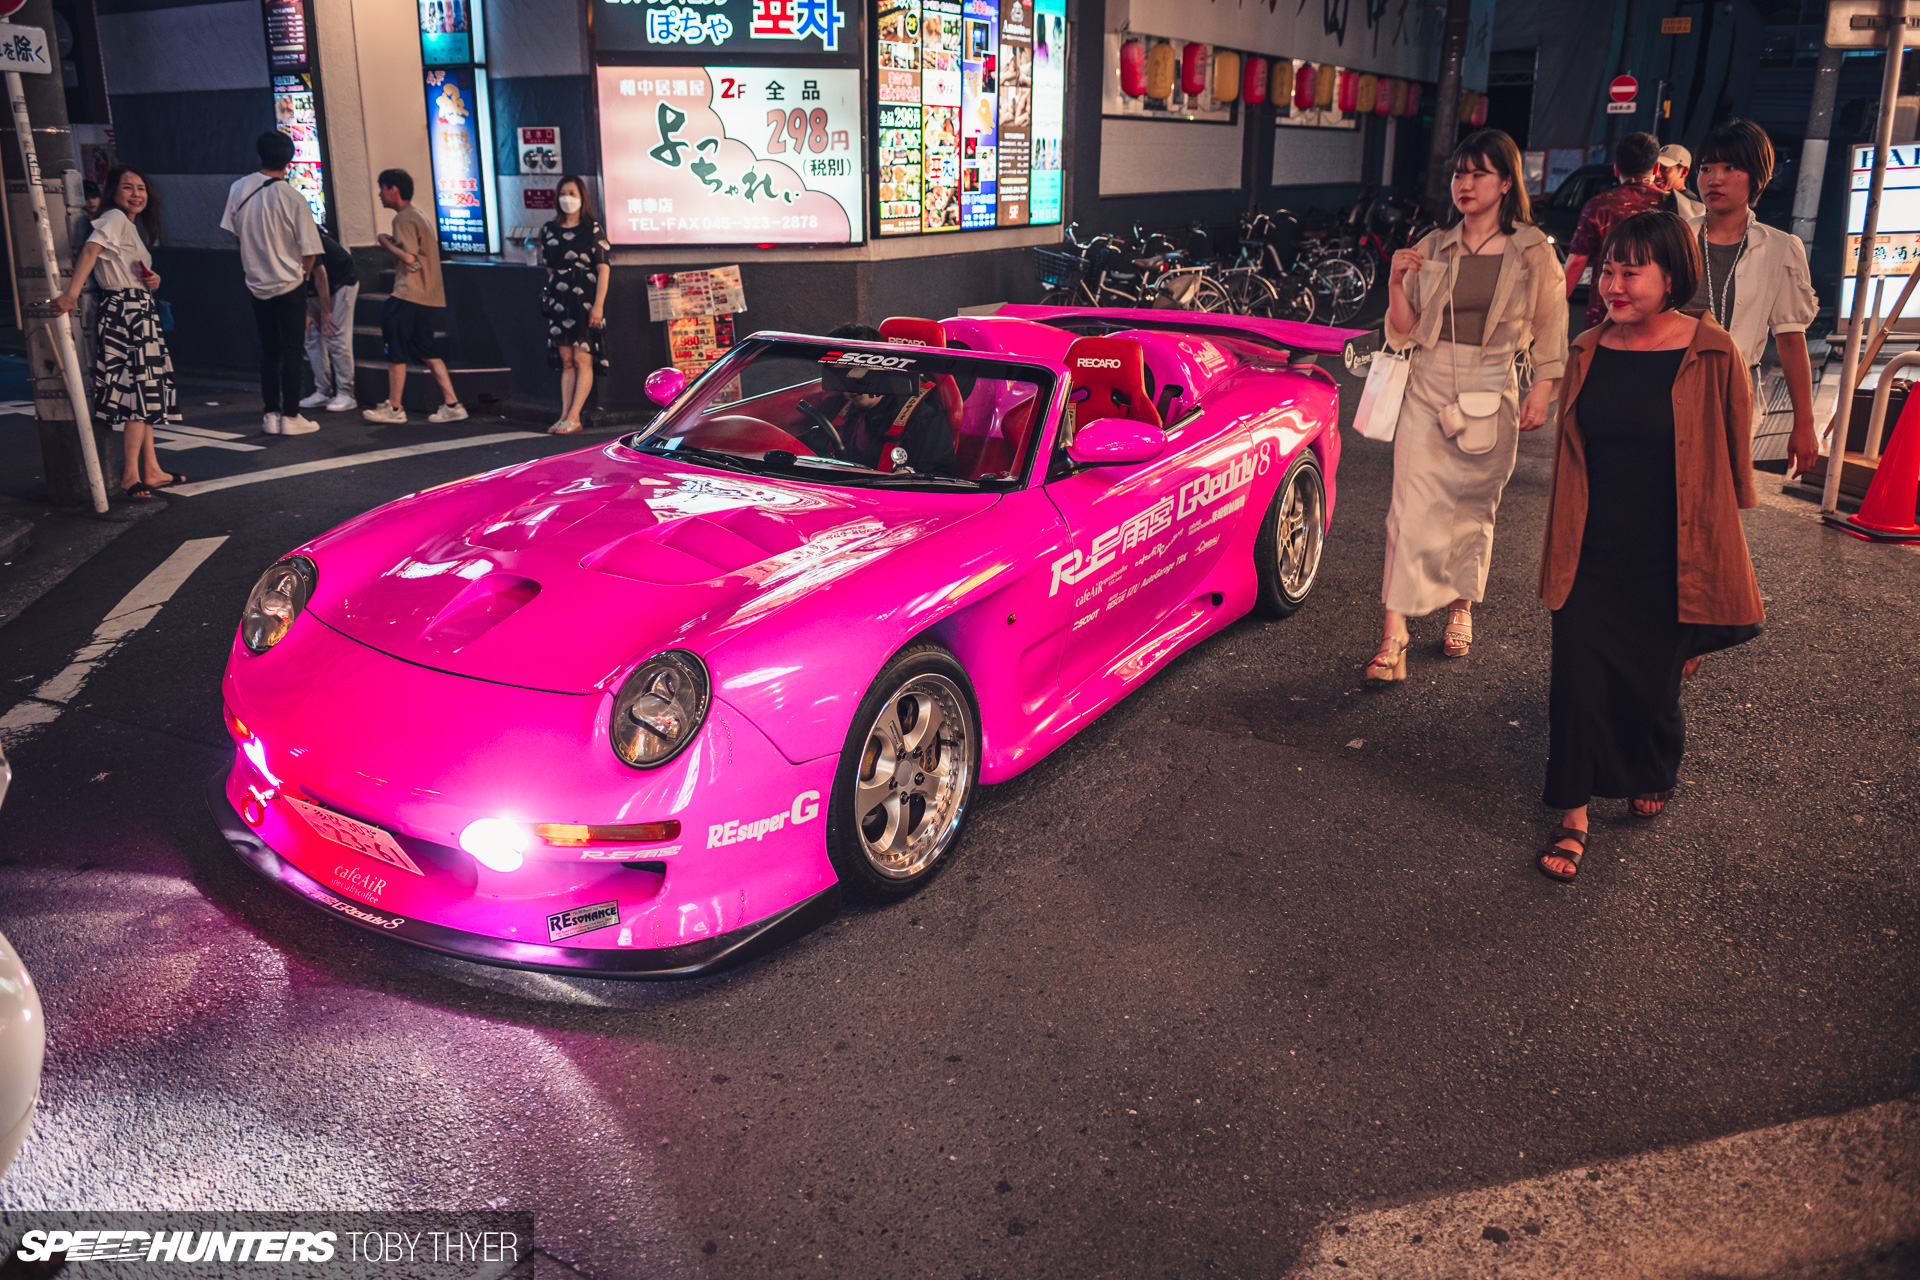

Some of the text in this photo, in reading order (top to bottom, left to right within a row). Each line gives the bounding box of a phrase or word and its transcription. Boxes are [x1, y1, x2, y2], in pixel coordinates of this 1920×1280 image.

[648, 8, 731, 43] ぽちゃ
[752, 0, 842, 48] 포차
[427, 71, 445, 86] 4F
[720, 78, 821, 101] 2F 全品
[766, 107, 850, 154] 298円
[888, 336, 926, 347] RECARO
[838, 352, 917, 369] SCOOT
[1077, 358, 1121, 369] RECARO
[1075, 580, 1103, 607] cafeAiR
[334, 865, 387, 896] cafeAiR
